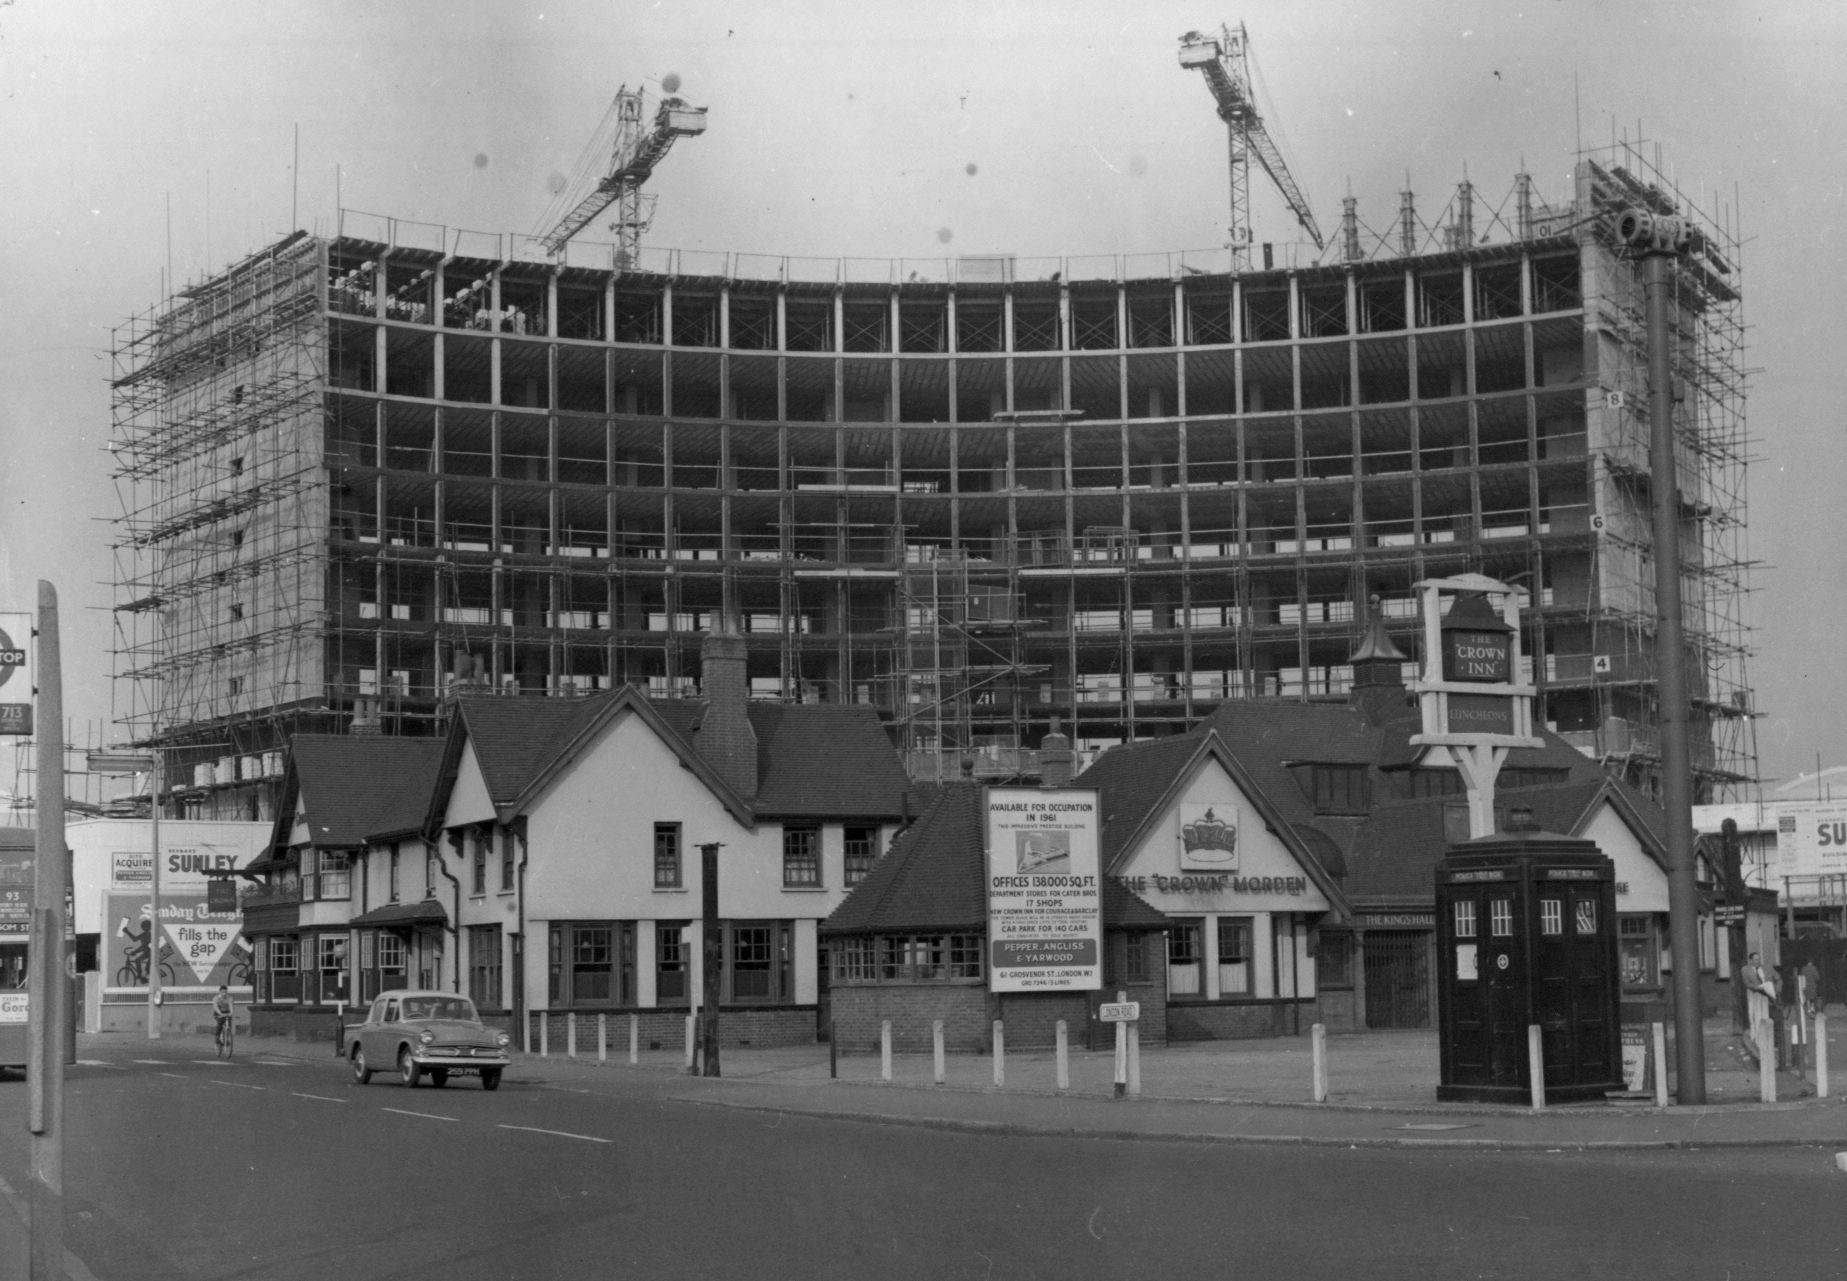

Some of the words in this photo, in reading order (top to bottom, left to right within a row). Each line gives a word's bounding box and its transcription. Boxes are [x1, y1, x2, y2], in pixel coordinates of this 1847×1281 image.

[1611, 394, 1620, 405] 8
[1594, 516, 1603, 529] 6
[1471, 634, 1491, 643] THE
[1596, 658, 1607, 670] 4
[2, 706, 22, 718] 713
[1449, 710, 1507, 721] LUNCHEONS
[990, 803, 1028, 812] AVAILABLE
[1031, 803, 1046, 812] FOR
[1049, 803, 1093, 812] OCCUPATION
[1026, 814, 1035, 822] IN
[1040, 813, 1056, 821] 1961
[116, 859, 152, 867] ACQUIRE
[168, 855, 238, 873] SUNLEY
[992, 876, 1029, 888] OFFICES
[1119, 876, 1146, 890] THE
[1233, 876, 1306, 891] MORDEN
[6, 892, 19, 901] 93
[139, 903, 194, 921] Snday
[1365, 914, 1382, 925] THE
[1412, 914, 1434, 925] HALL
[178, 928, 202, 940] fills
[206, 928, 227, 940] the
[190, 943, 216, 957] gap
[1043, 942, 1085, 950] ANGLISS
[1025, 953, 1073, 961] YARWOOD
